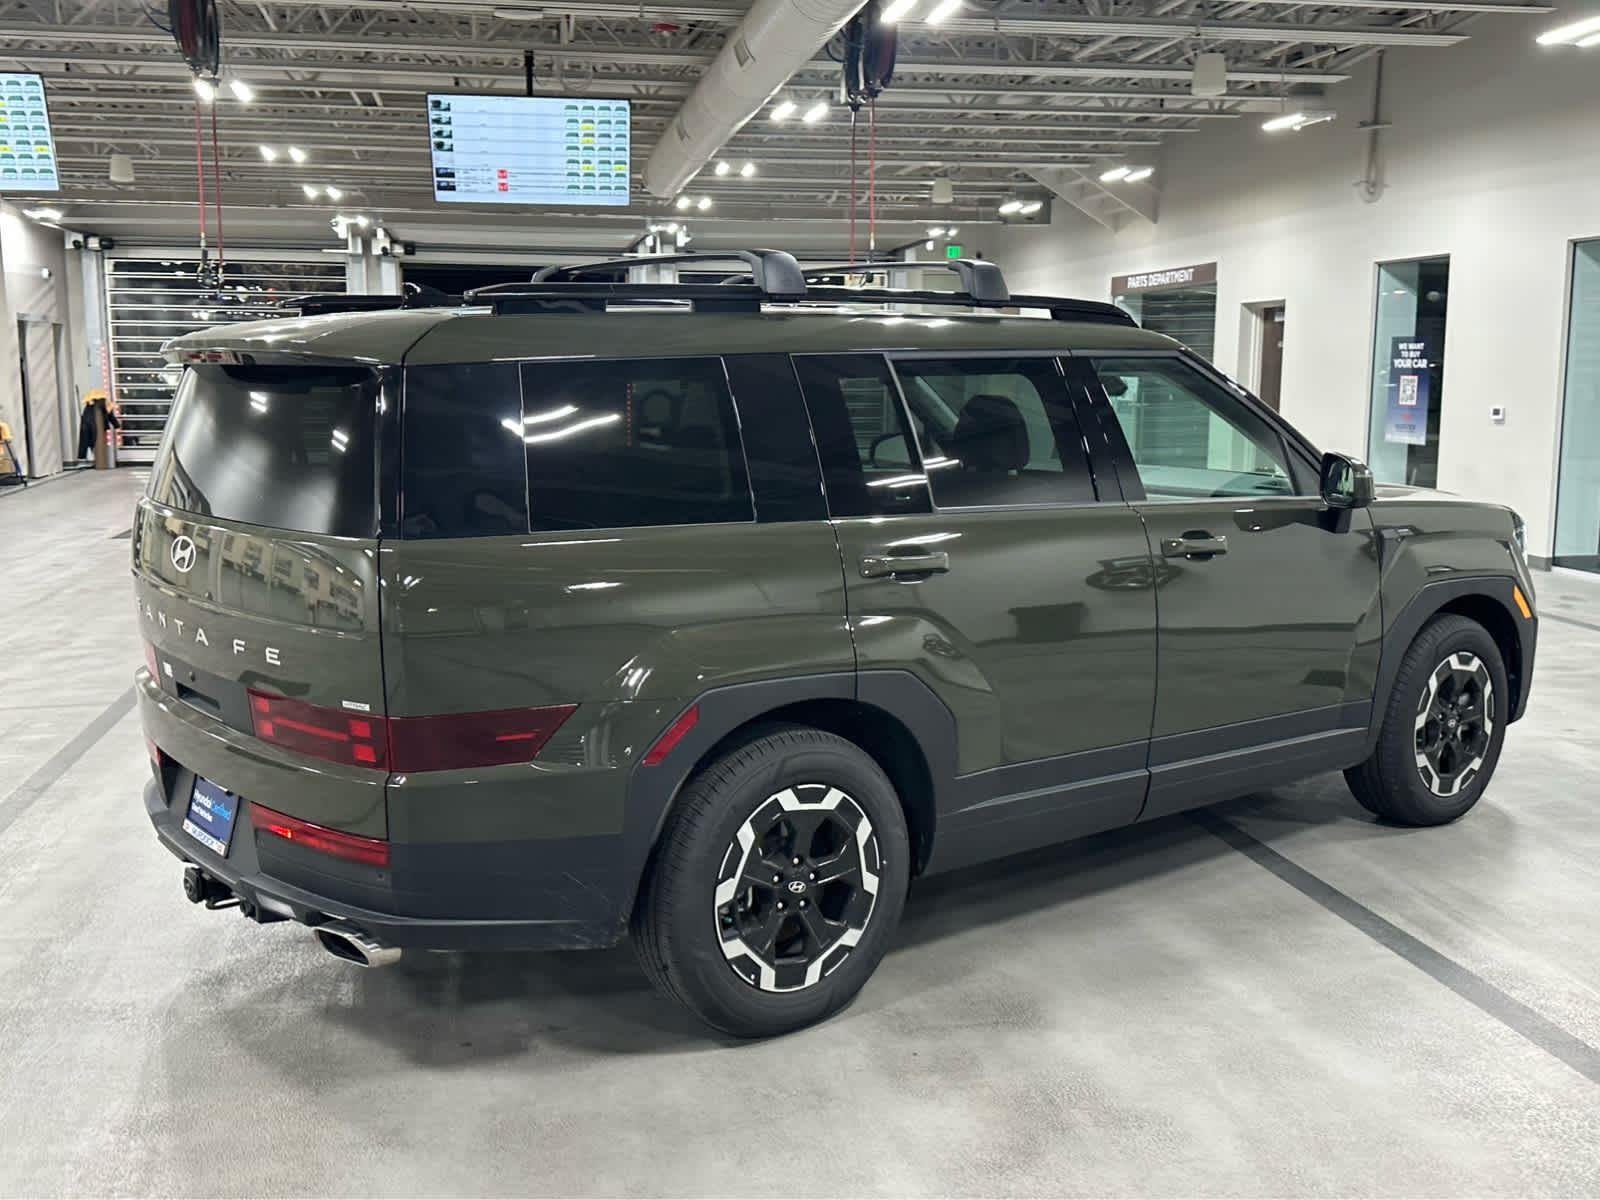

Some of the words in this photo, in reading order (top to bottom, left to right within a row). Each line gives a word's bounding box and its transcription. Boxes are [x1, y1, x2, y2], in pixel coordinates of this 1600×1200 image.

[1127, 275, 1148, 289] PARTS
[1148, 268, 1195, 286] DEPARTMENT
[1393, 358, 1412, 369] YOUR
[1412, 358, 1428, 369] CAR
[232, 638, 281, 667] FE
